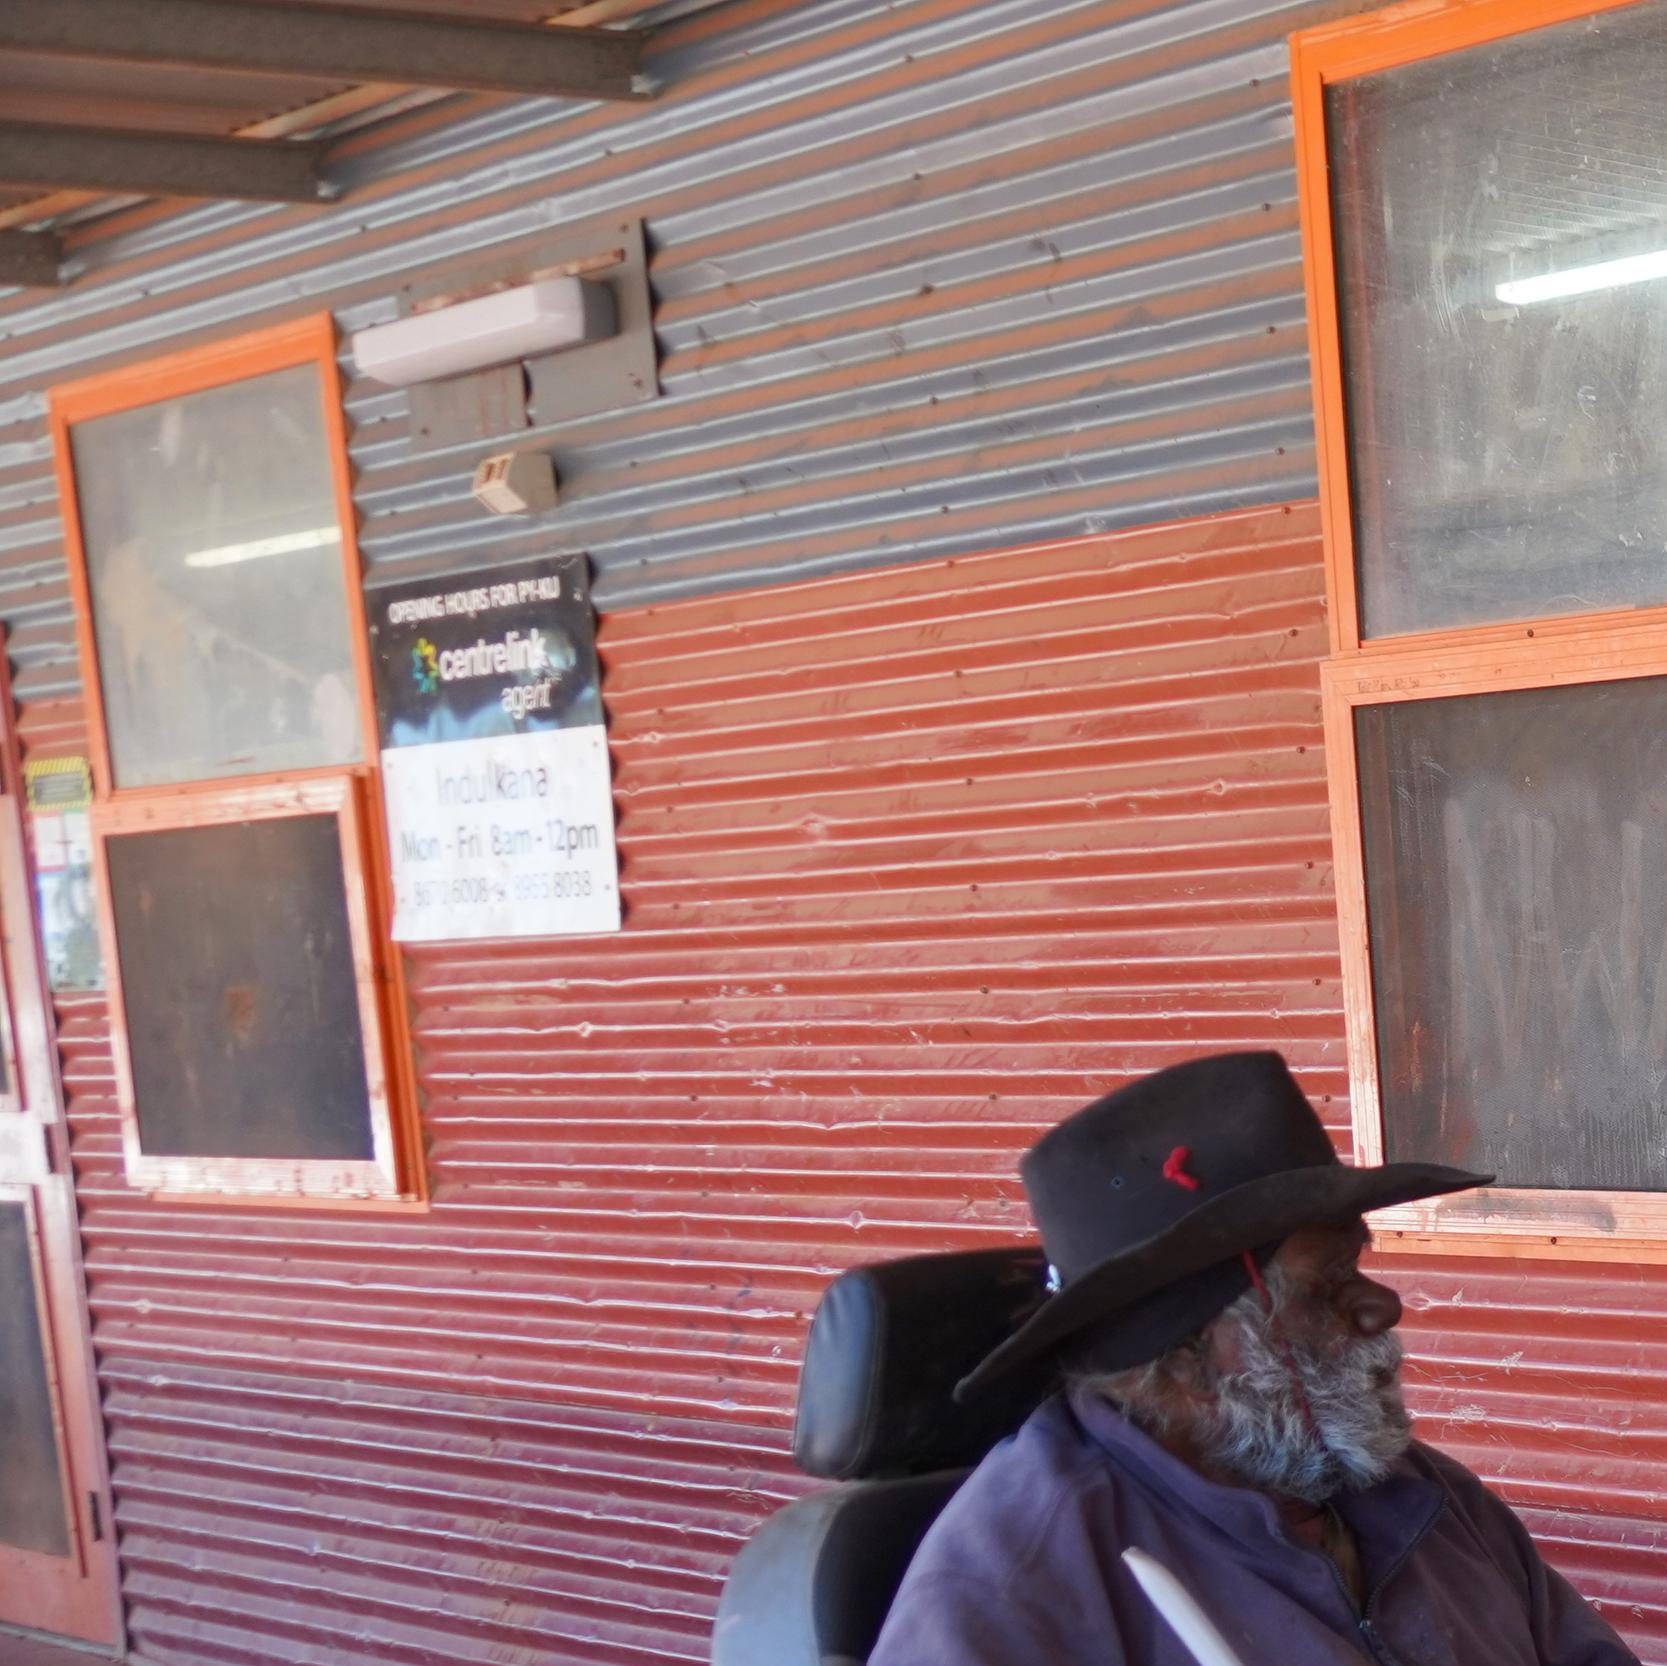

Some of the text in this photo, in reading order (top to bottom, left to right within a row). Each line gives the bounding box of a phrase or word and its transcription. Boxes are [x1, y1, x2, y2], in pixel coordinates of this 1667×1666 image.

[387, 595, 445, 624] OPENING
[445, 588, 491, 616] HOURS
[491, 583, 518, 607] FOR
[438, 628, 547, 681] centrelink
[501, 680, 551, 719] agent
[436, 759, 547, 805] Indulkana
[402, 831, 441, 862] Mon
[457, 826, 483, 858] Fri
[491, 823, 532, 856] 8am
[546, 819, 599, 859] 12pm
